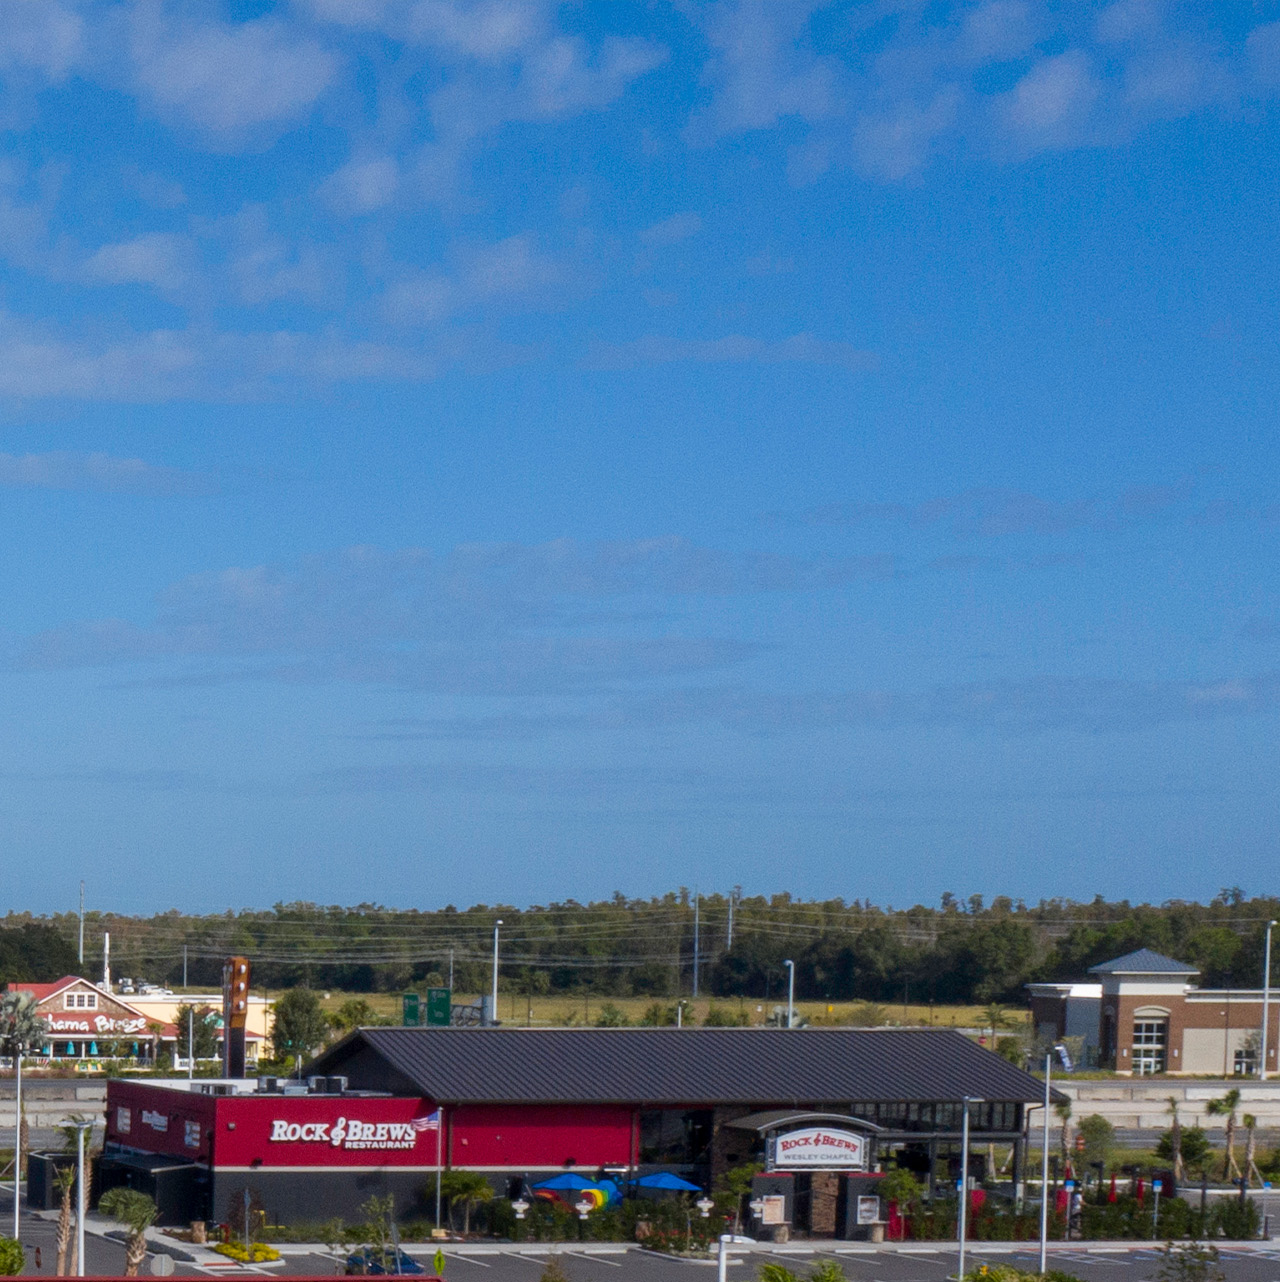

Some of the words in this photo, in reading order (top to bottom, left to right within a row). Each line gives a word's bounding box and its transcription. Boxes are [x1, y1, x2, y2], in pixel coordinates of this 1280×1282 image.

[40, 1013, 90, 1032] hama
[270, 1120, 331, 1141] ROCK
[345, 1120, 416, 1141] BREWS
[345, 1141, 416, 1149] RESTAURANT
[781, 1136, 812, 1151] ROCK
[822, 1135, 858, 1152] BREWS
